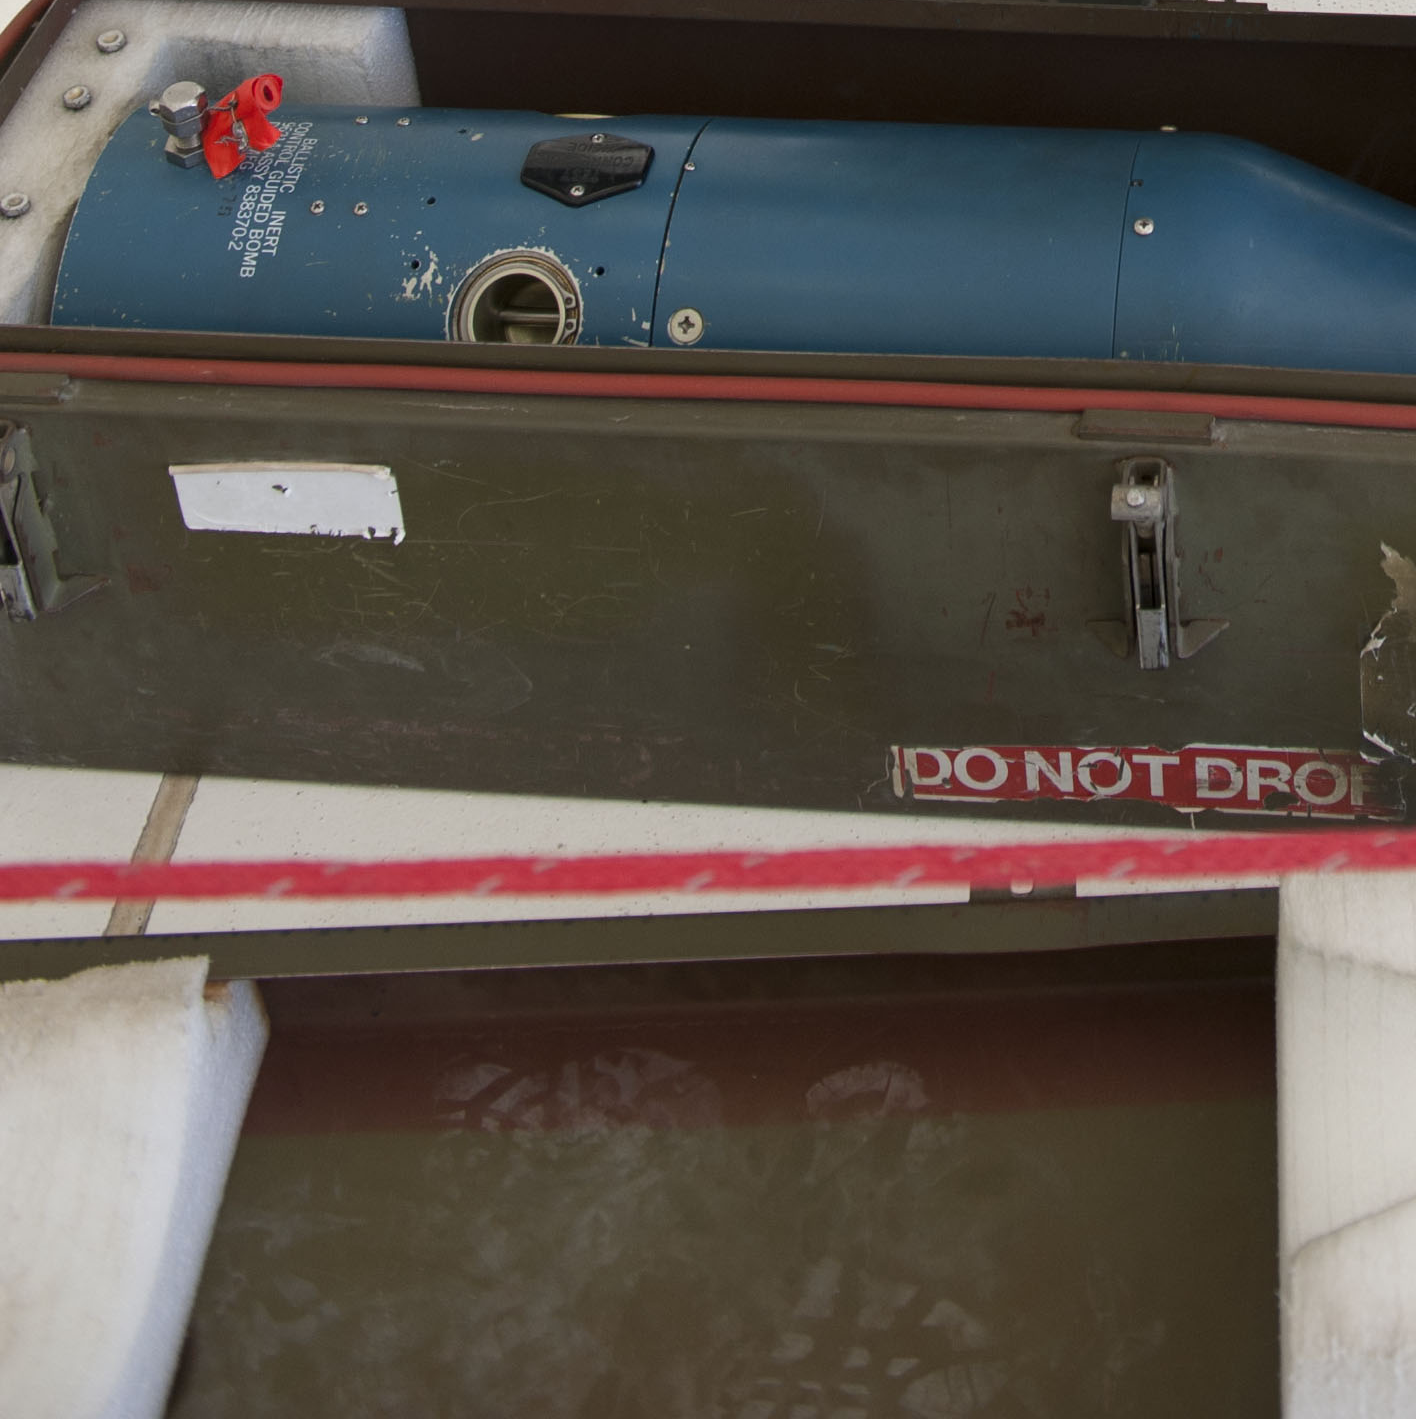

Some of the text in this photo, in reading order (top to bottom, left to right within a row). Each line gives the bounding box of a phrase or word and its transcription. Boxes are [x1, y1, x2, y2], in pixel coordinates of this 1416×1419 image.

[251, 151, 275, 181] ASSY
[261, 138, 318, 256] BALLISTIC INERT
[228, 184, 261, 251] 838370-2
[240, 122, 312, 278] CONTROL GUIDED BOMB
[905, 747, 1009, 791] DO
[1024, 749, 1180, 797] NOT
